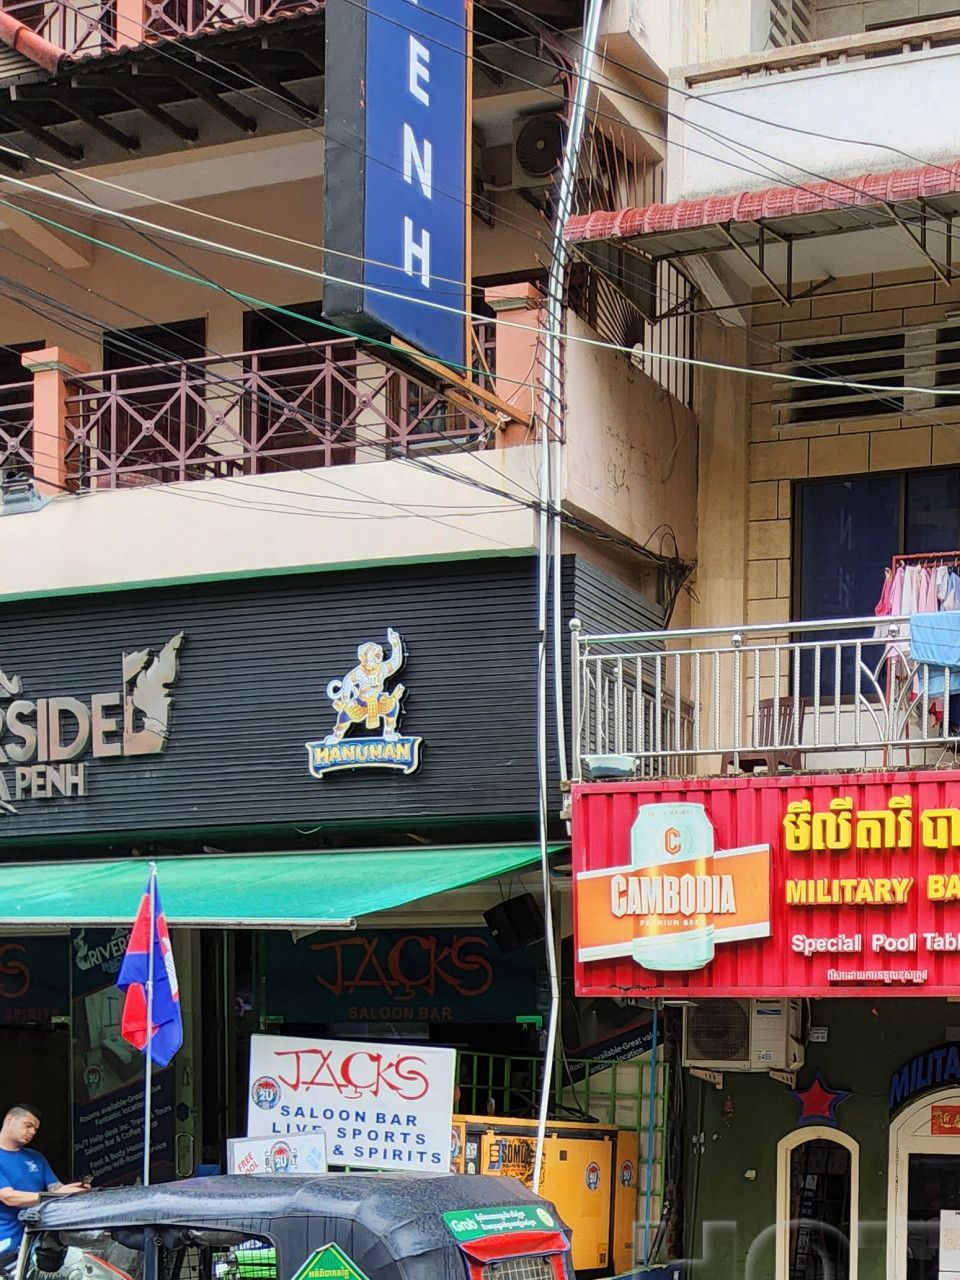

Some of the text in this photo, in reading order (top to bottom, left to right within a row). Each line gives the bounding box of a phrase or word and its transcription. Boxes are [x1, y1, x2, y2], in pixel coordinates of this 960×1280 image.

[402, 0, 432, 289] ENH
[313, 742, 412, 767] HANUMAN
[15, 762, 89, 801] PENH
[611, 873, 736, 917] CAMBODIA
[786, 877, 913, 904] MILITARY
[88, 934, 131, 967] RIVER
[791, 933, 862, 956] Special
[872, 934, 916, 952] Pool
[350, 1006, 453, 1020] SALOON BAR
[259, 1089, 275, 1101] 2U
[281, 1105, 418, 1127] SALOON BAR
[337, 1127, 426, 1145] SPORTS
[237, 1151, 255, 1172] FREE
[332, 1144, 442, 1164] & SPIRITS
[244, 1160, 260, 1174] OOL
[450, 1219, 478, 1232] Grab
